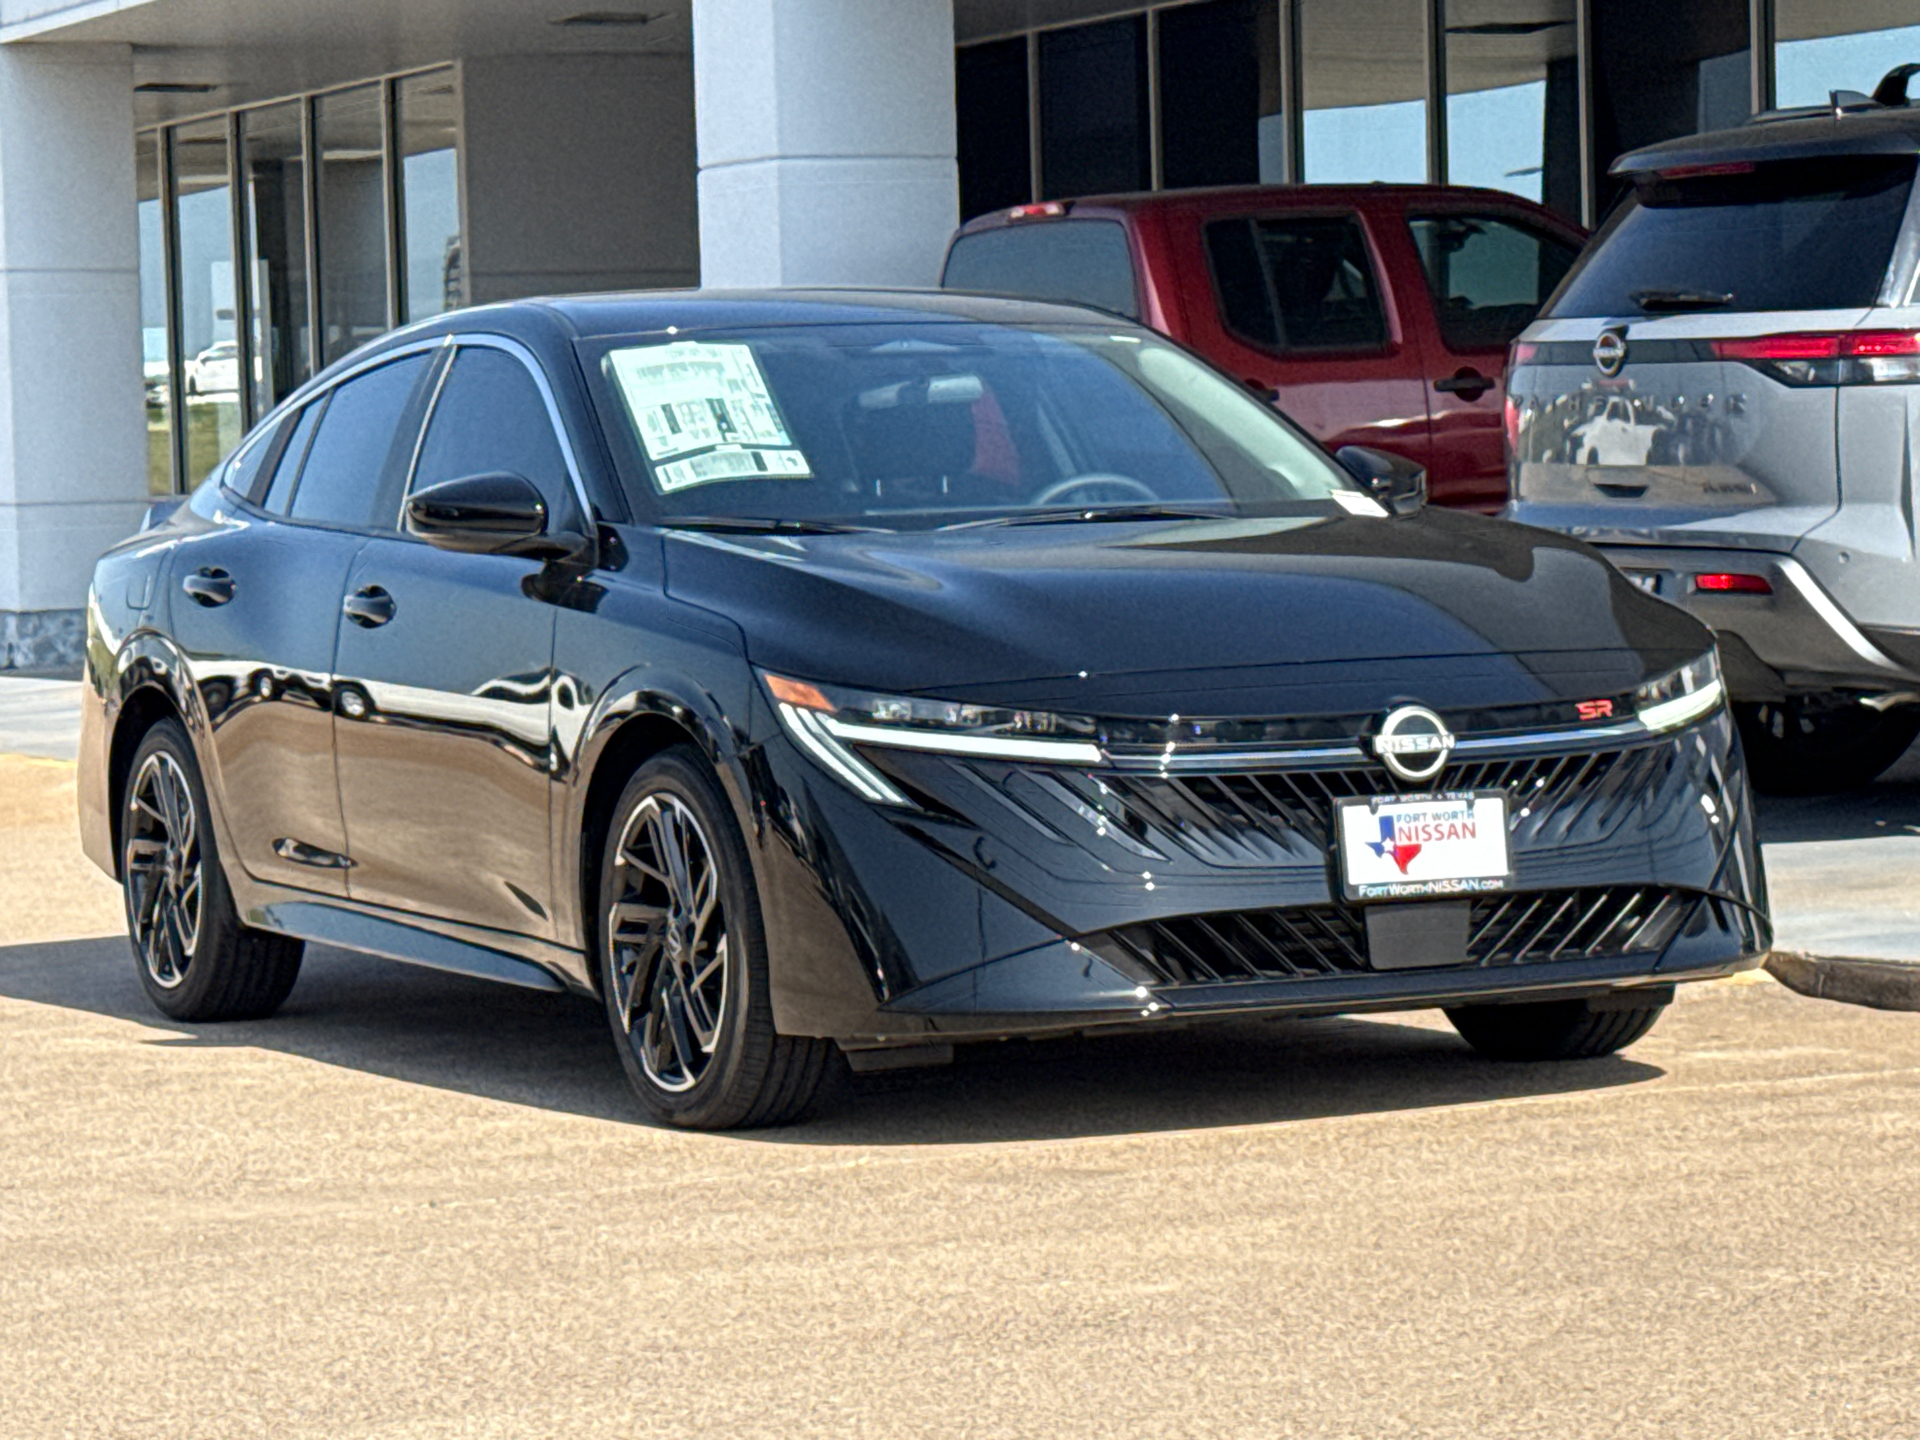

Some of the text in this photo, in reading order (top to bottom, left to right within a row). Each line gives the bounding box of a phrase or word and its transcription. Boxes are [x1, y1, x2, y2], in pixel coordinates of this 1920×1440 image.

[1575, 699, 1613, 720] SR
[1376, 734, 1455, 753] NISSAN
[1396, 809, 1475, 824] FORT WORTH
[1398, 822, 1477, 843] NISSAN
